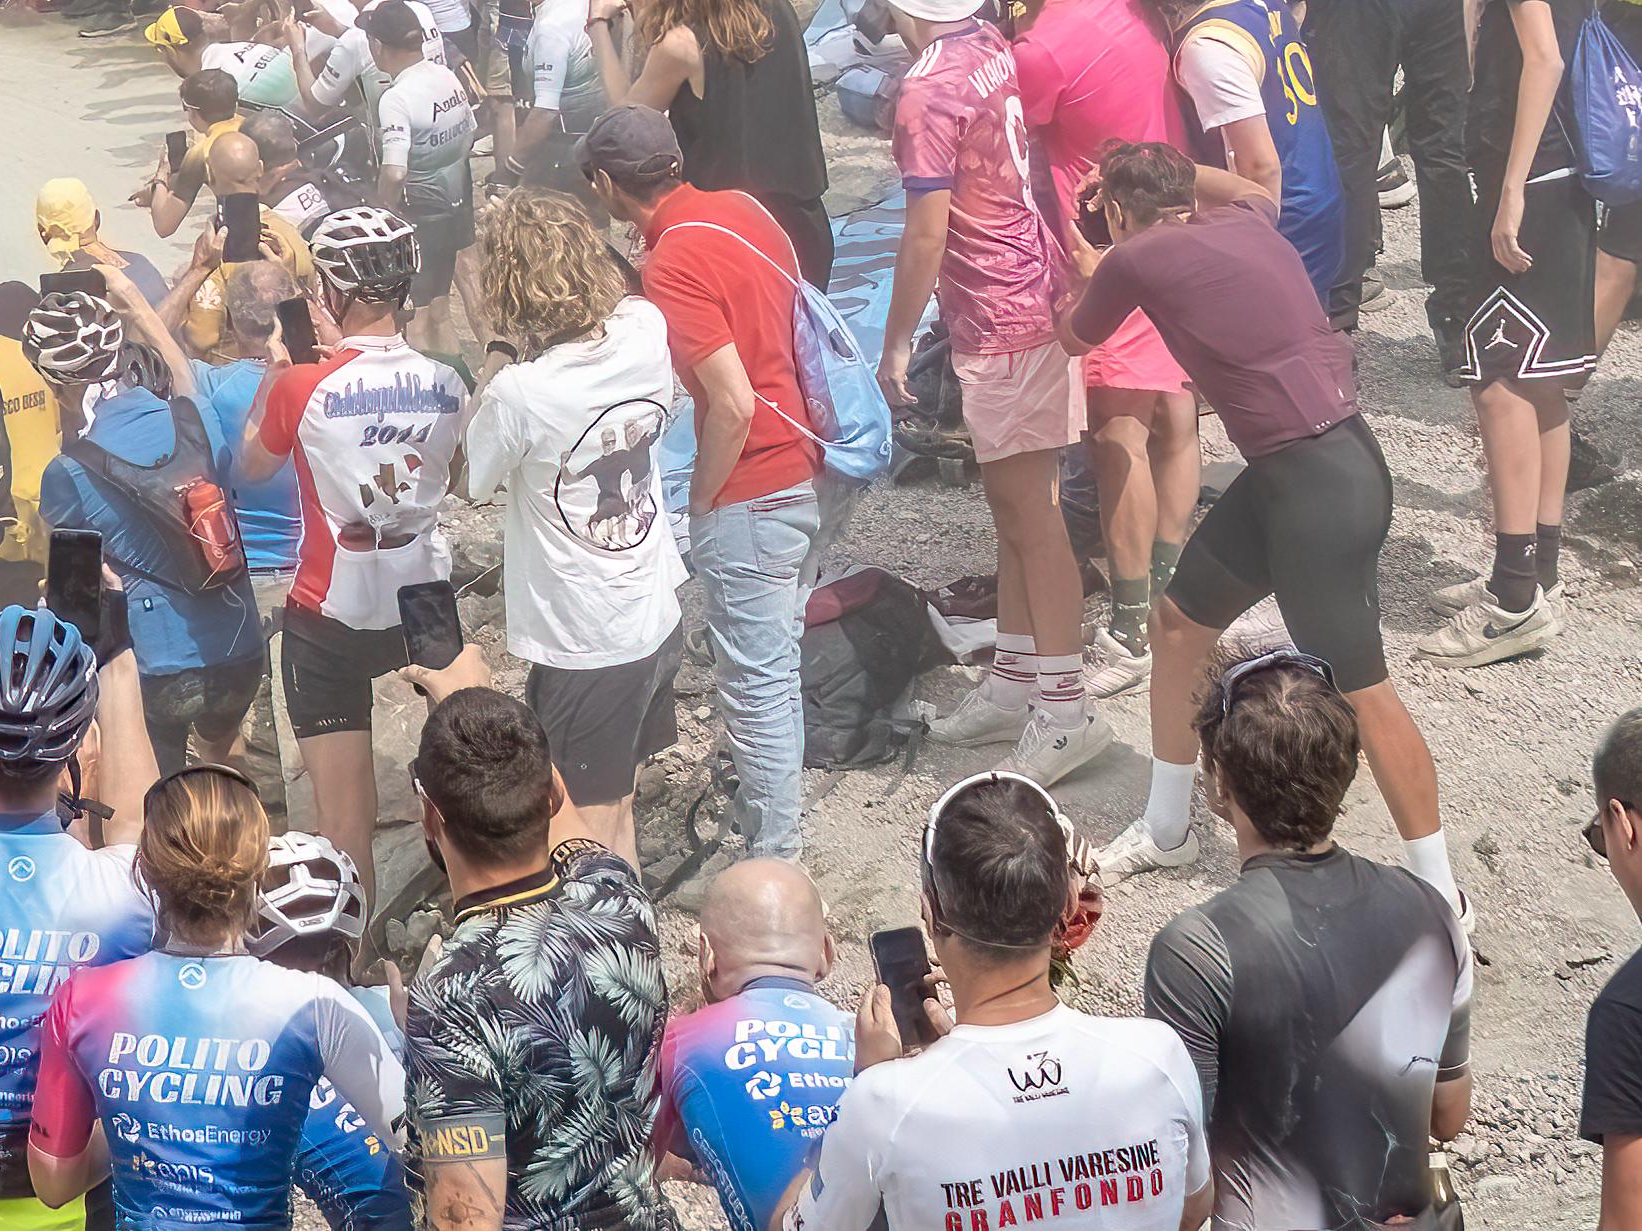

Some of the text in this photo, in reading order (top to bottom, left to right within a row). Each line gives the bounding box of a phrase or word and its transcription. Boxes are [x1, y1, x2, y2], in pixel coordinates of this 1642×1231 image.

[735, 1019, 854, 1043] POLI
[108, 1032, 271, 1071] POLITO
[98, 1067, 284, 1107] CYCLING
[147, 1121, 271, 1146] EthosEnergy
[941, 1138, 1161, 1209] TRE VALLI VARESINE
